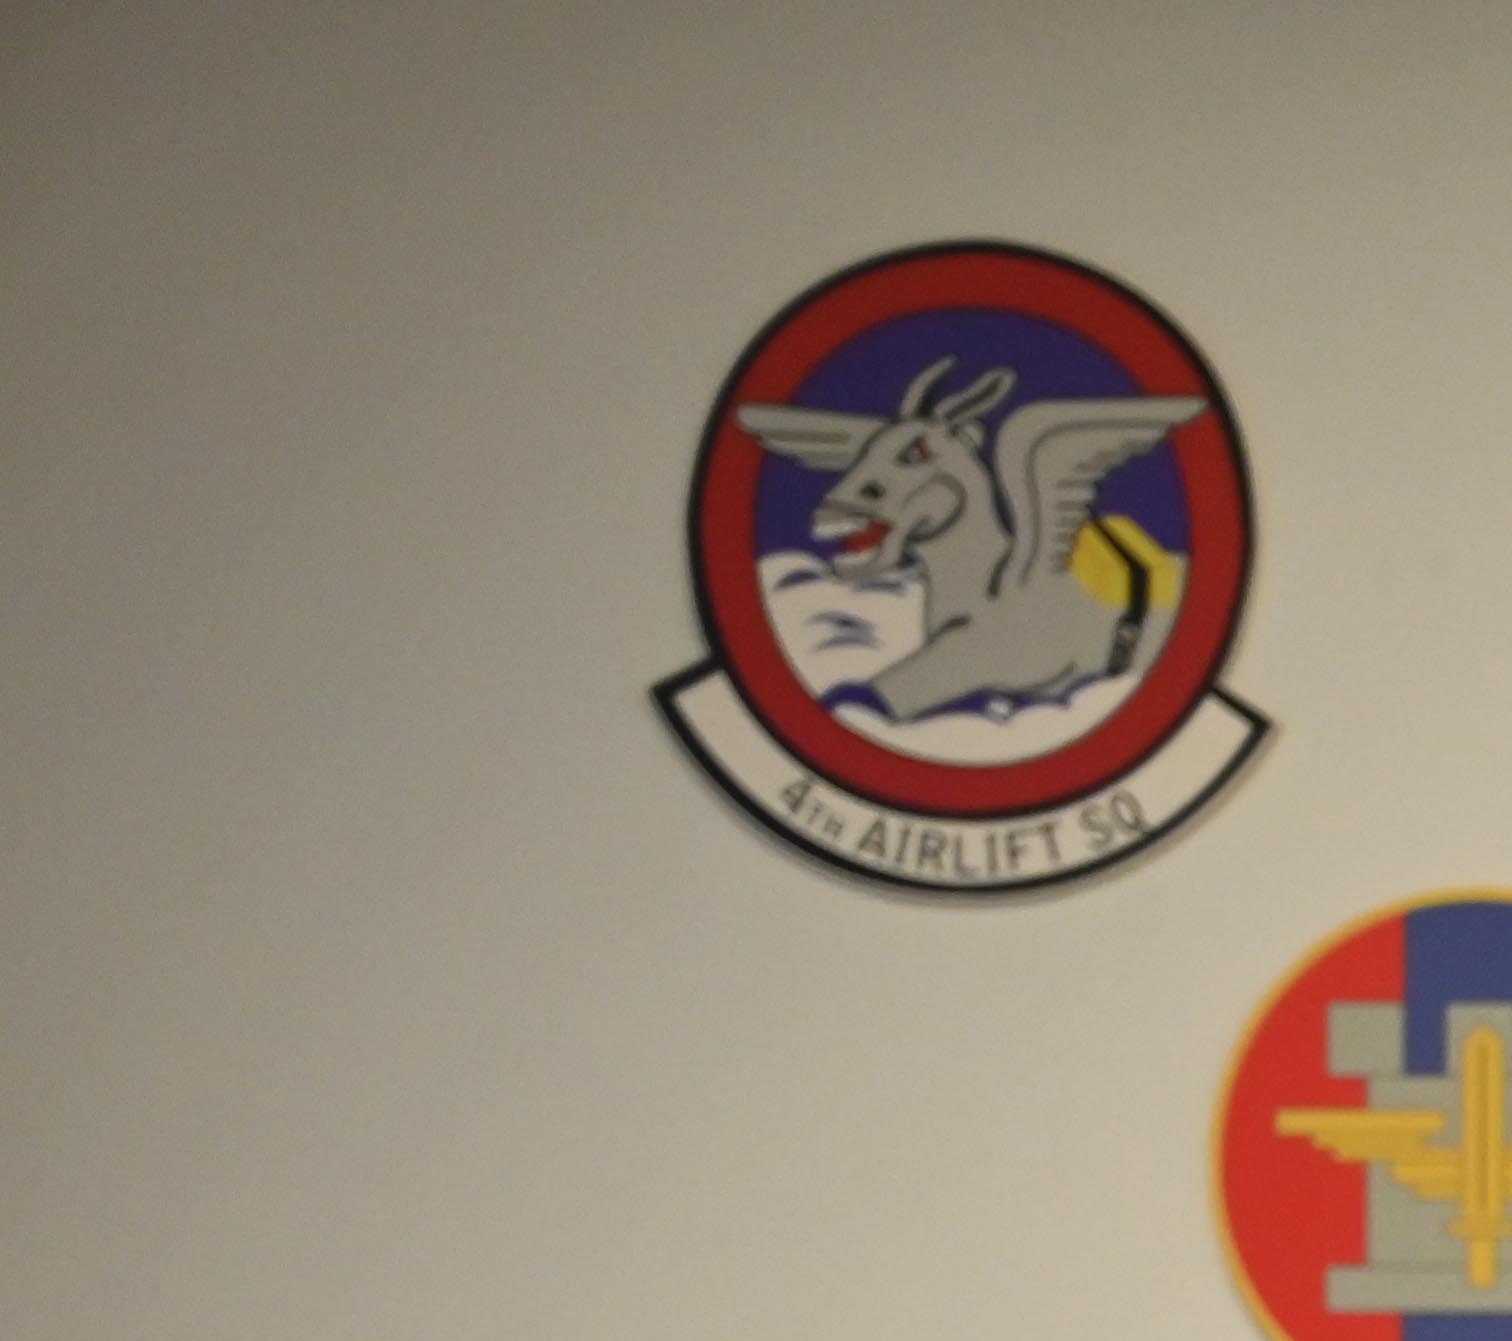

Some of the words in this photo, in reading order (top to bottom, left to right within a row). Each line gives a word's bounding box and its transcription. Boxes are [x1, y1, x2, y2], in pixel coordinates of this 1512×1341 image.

[779, 776, 846, 842] 4TH
[857, 819, 1063, 877] AIRLIFT
[1078, 787, 1150, 852] SQ
